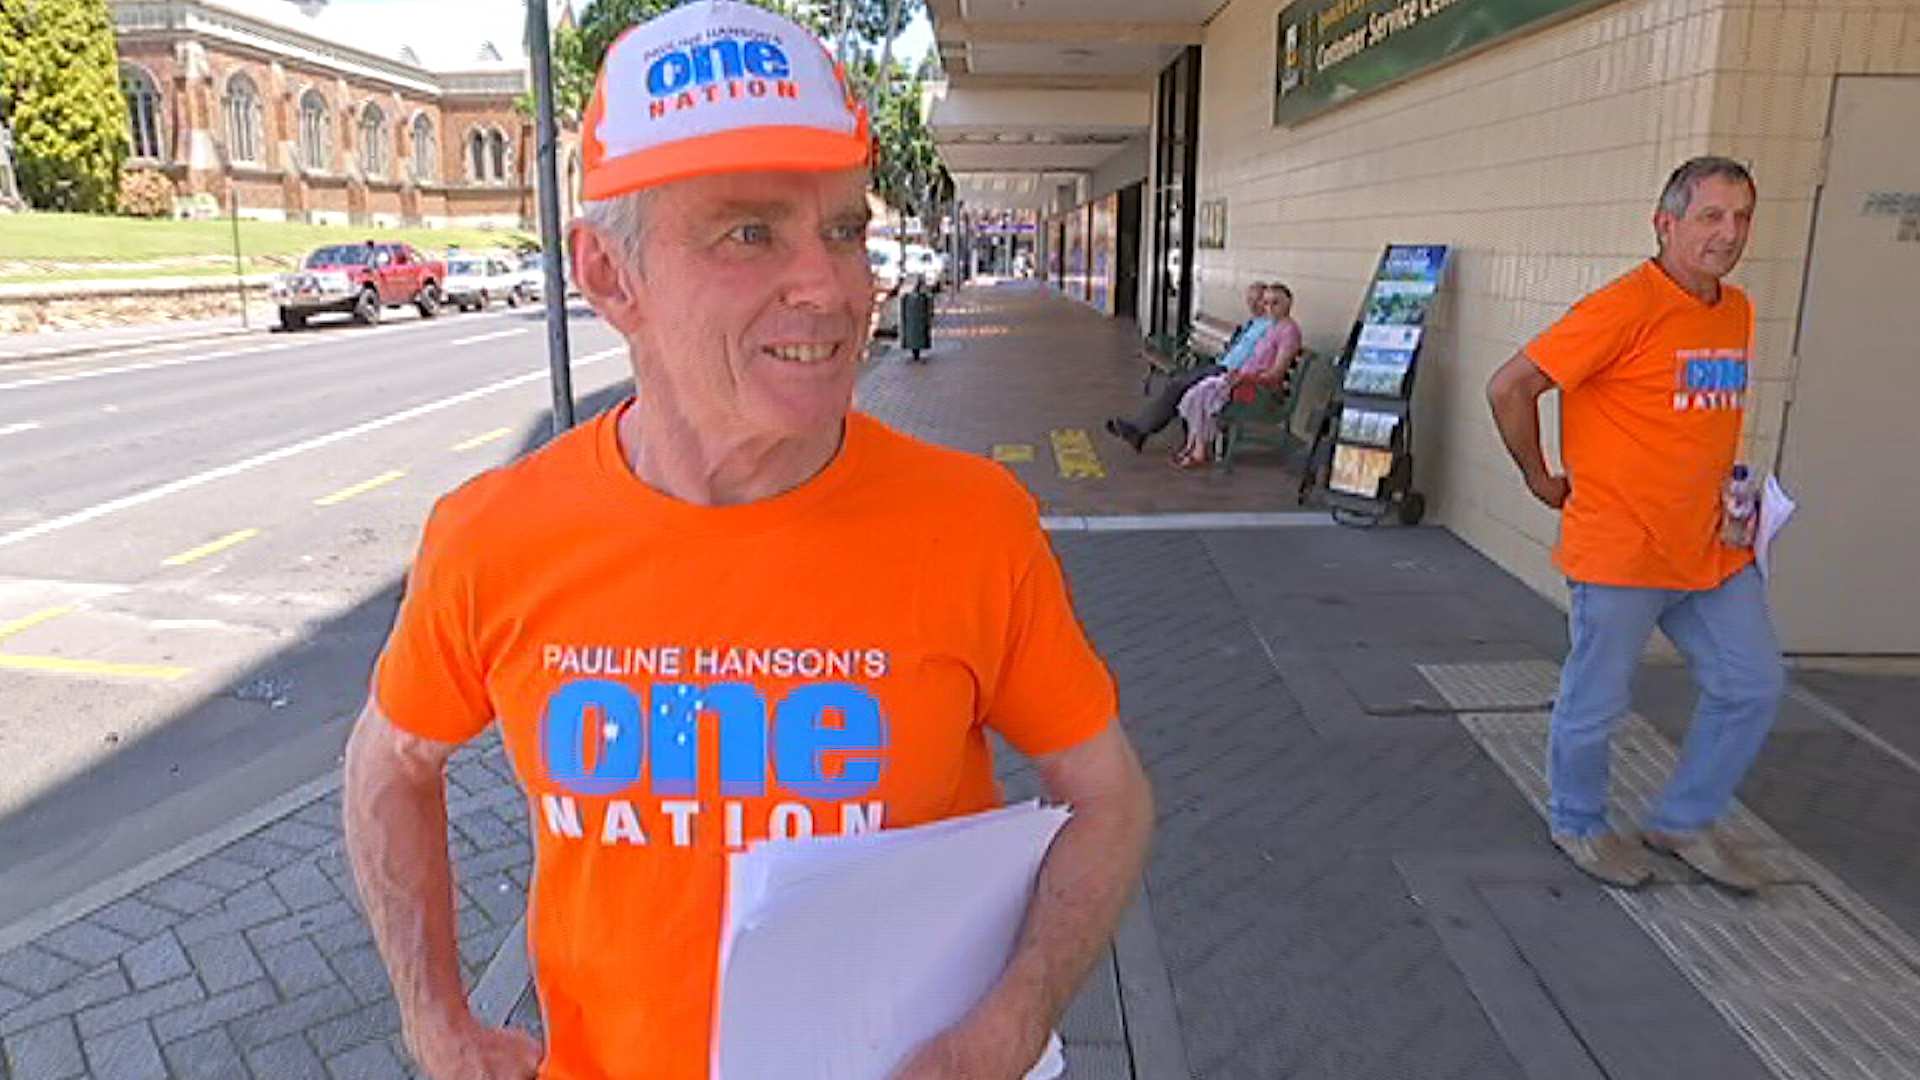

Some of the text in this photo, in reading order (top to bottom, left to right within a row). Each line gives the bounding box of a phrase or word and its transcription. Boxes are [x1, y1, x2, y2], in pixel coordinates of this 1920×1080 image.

[647, 40, 790, 97] one
[649, 79, 799, 119] NATION
[1673, 391, 1741, 411] NATI
[543, 645, 887, 678] PAULINE HANSON'S
[539, 678, 890, 800] one
[541, 795, 885, 847] NATION
